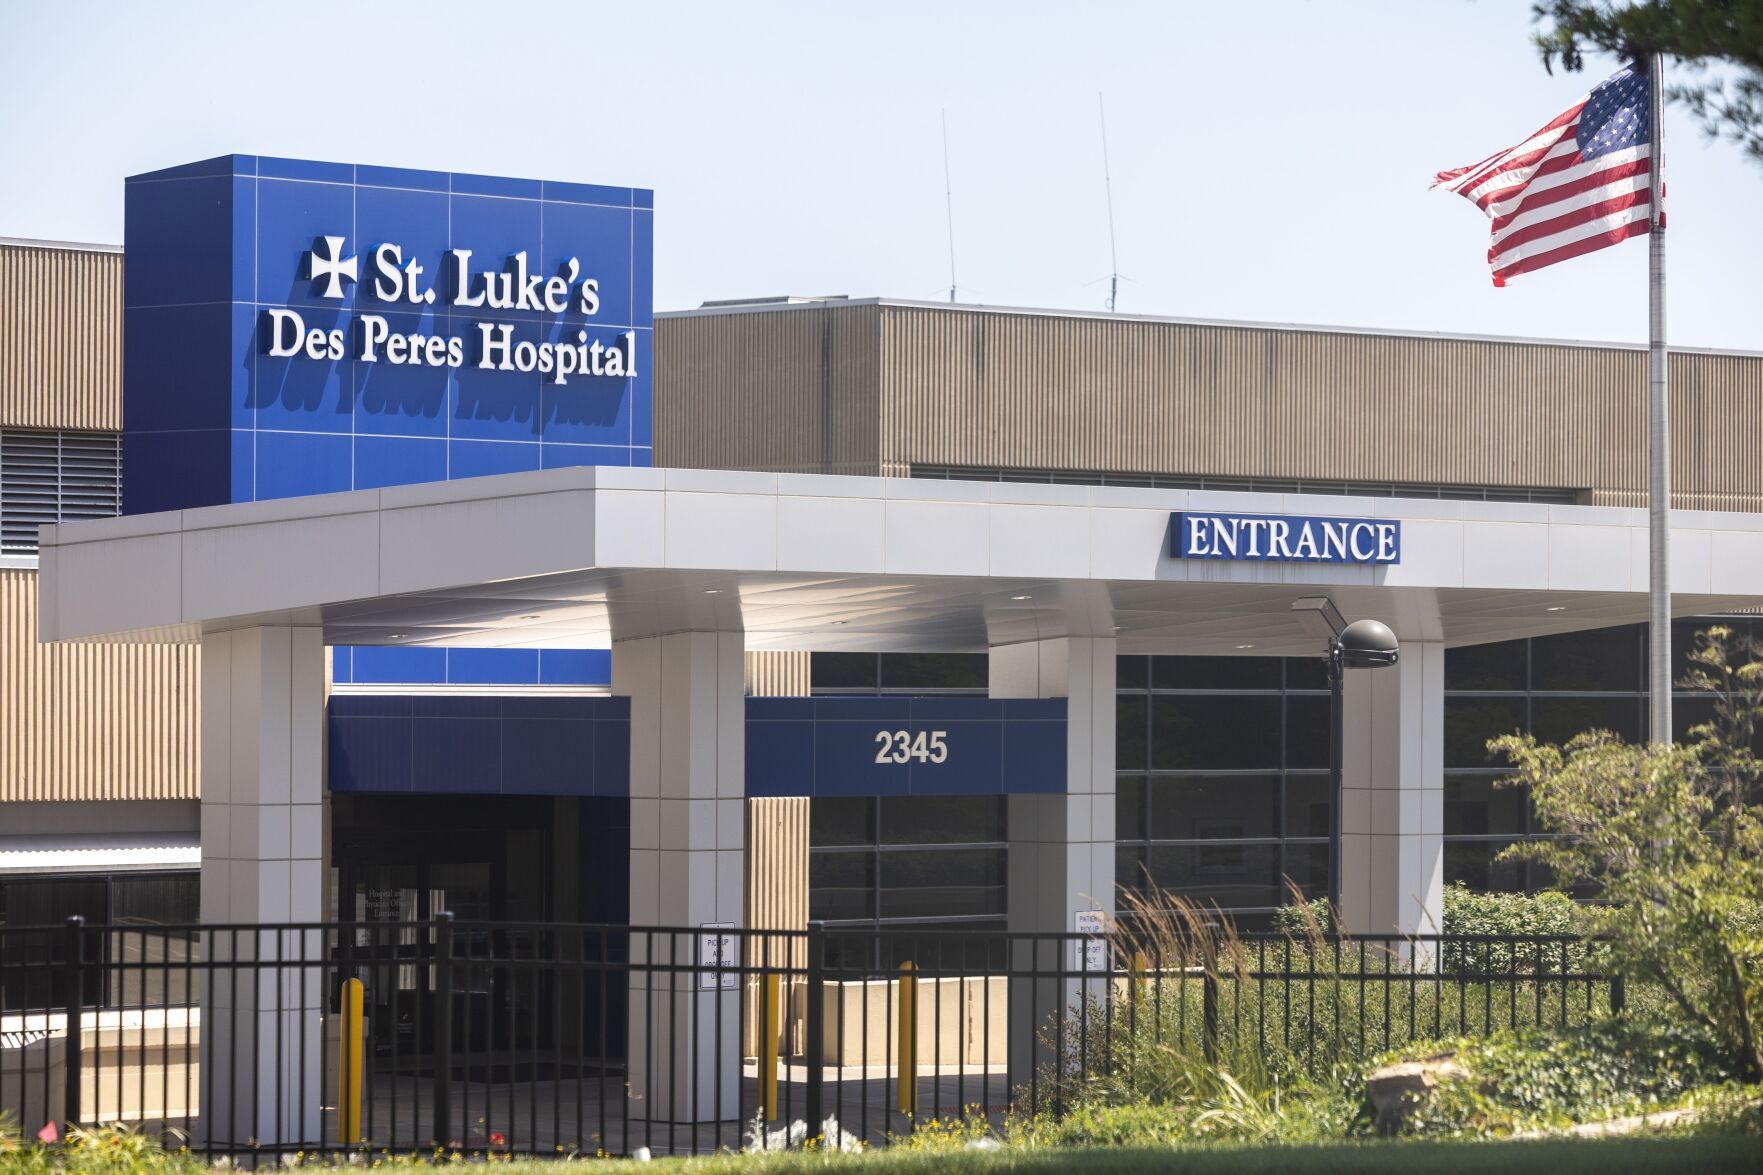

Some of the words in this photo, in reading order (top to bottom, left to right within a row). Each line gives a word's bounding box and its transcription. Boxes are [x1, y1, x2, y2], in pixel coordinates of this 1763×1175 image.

[374, 242, 437, 305] St.
[452, 248, 600, 316] Luke's
[268, 308, 345, 361] Des
[360, 314, 464, 368] Peres
[478, 322, 638, 386] Hospital
[1187, 516, 1397, 561] ENTRANCE
[874, 730, 948, 764] 2345
